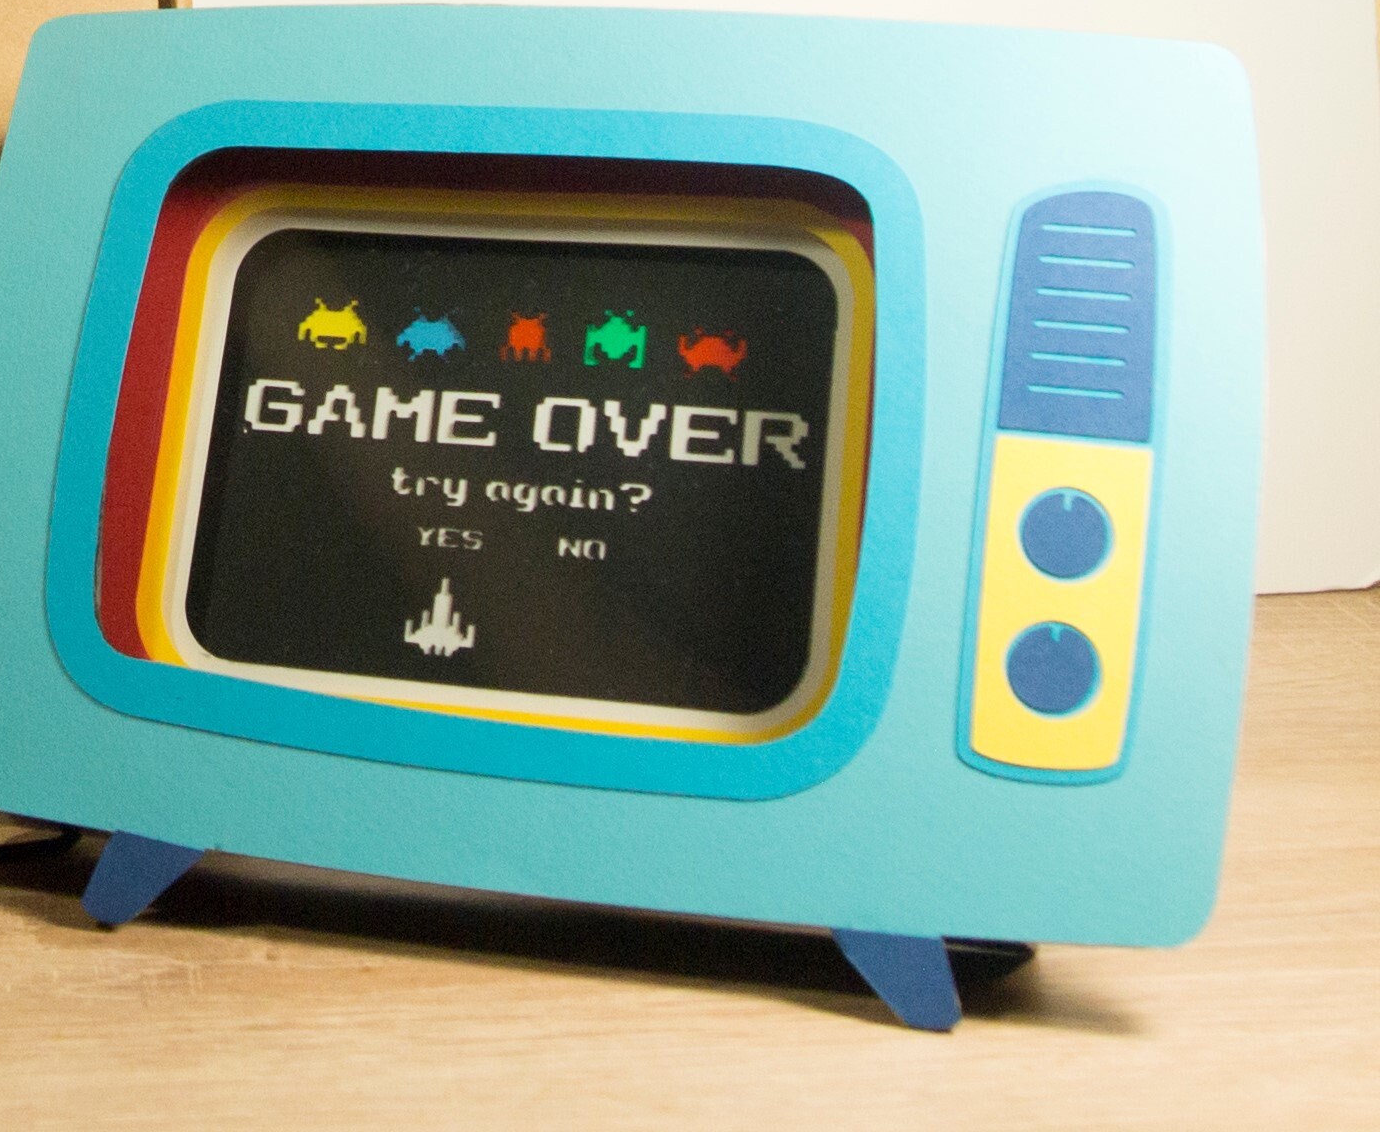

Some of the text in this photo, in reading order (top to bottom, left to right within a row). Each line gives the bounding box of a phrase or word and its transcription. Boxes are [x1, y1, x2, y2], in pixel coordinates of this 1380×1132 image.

[243, 378, 809, 468] GAME OVER
[391, 467, 653, 513] try again?
[417, 526, 607, 560] YES NO
